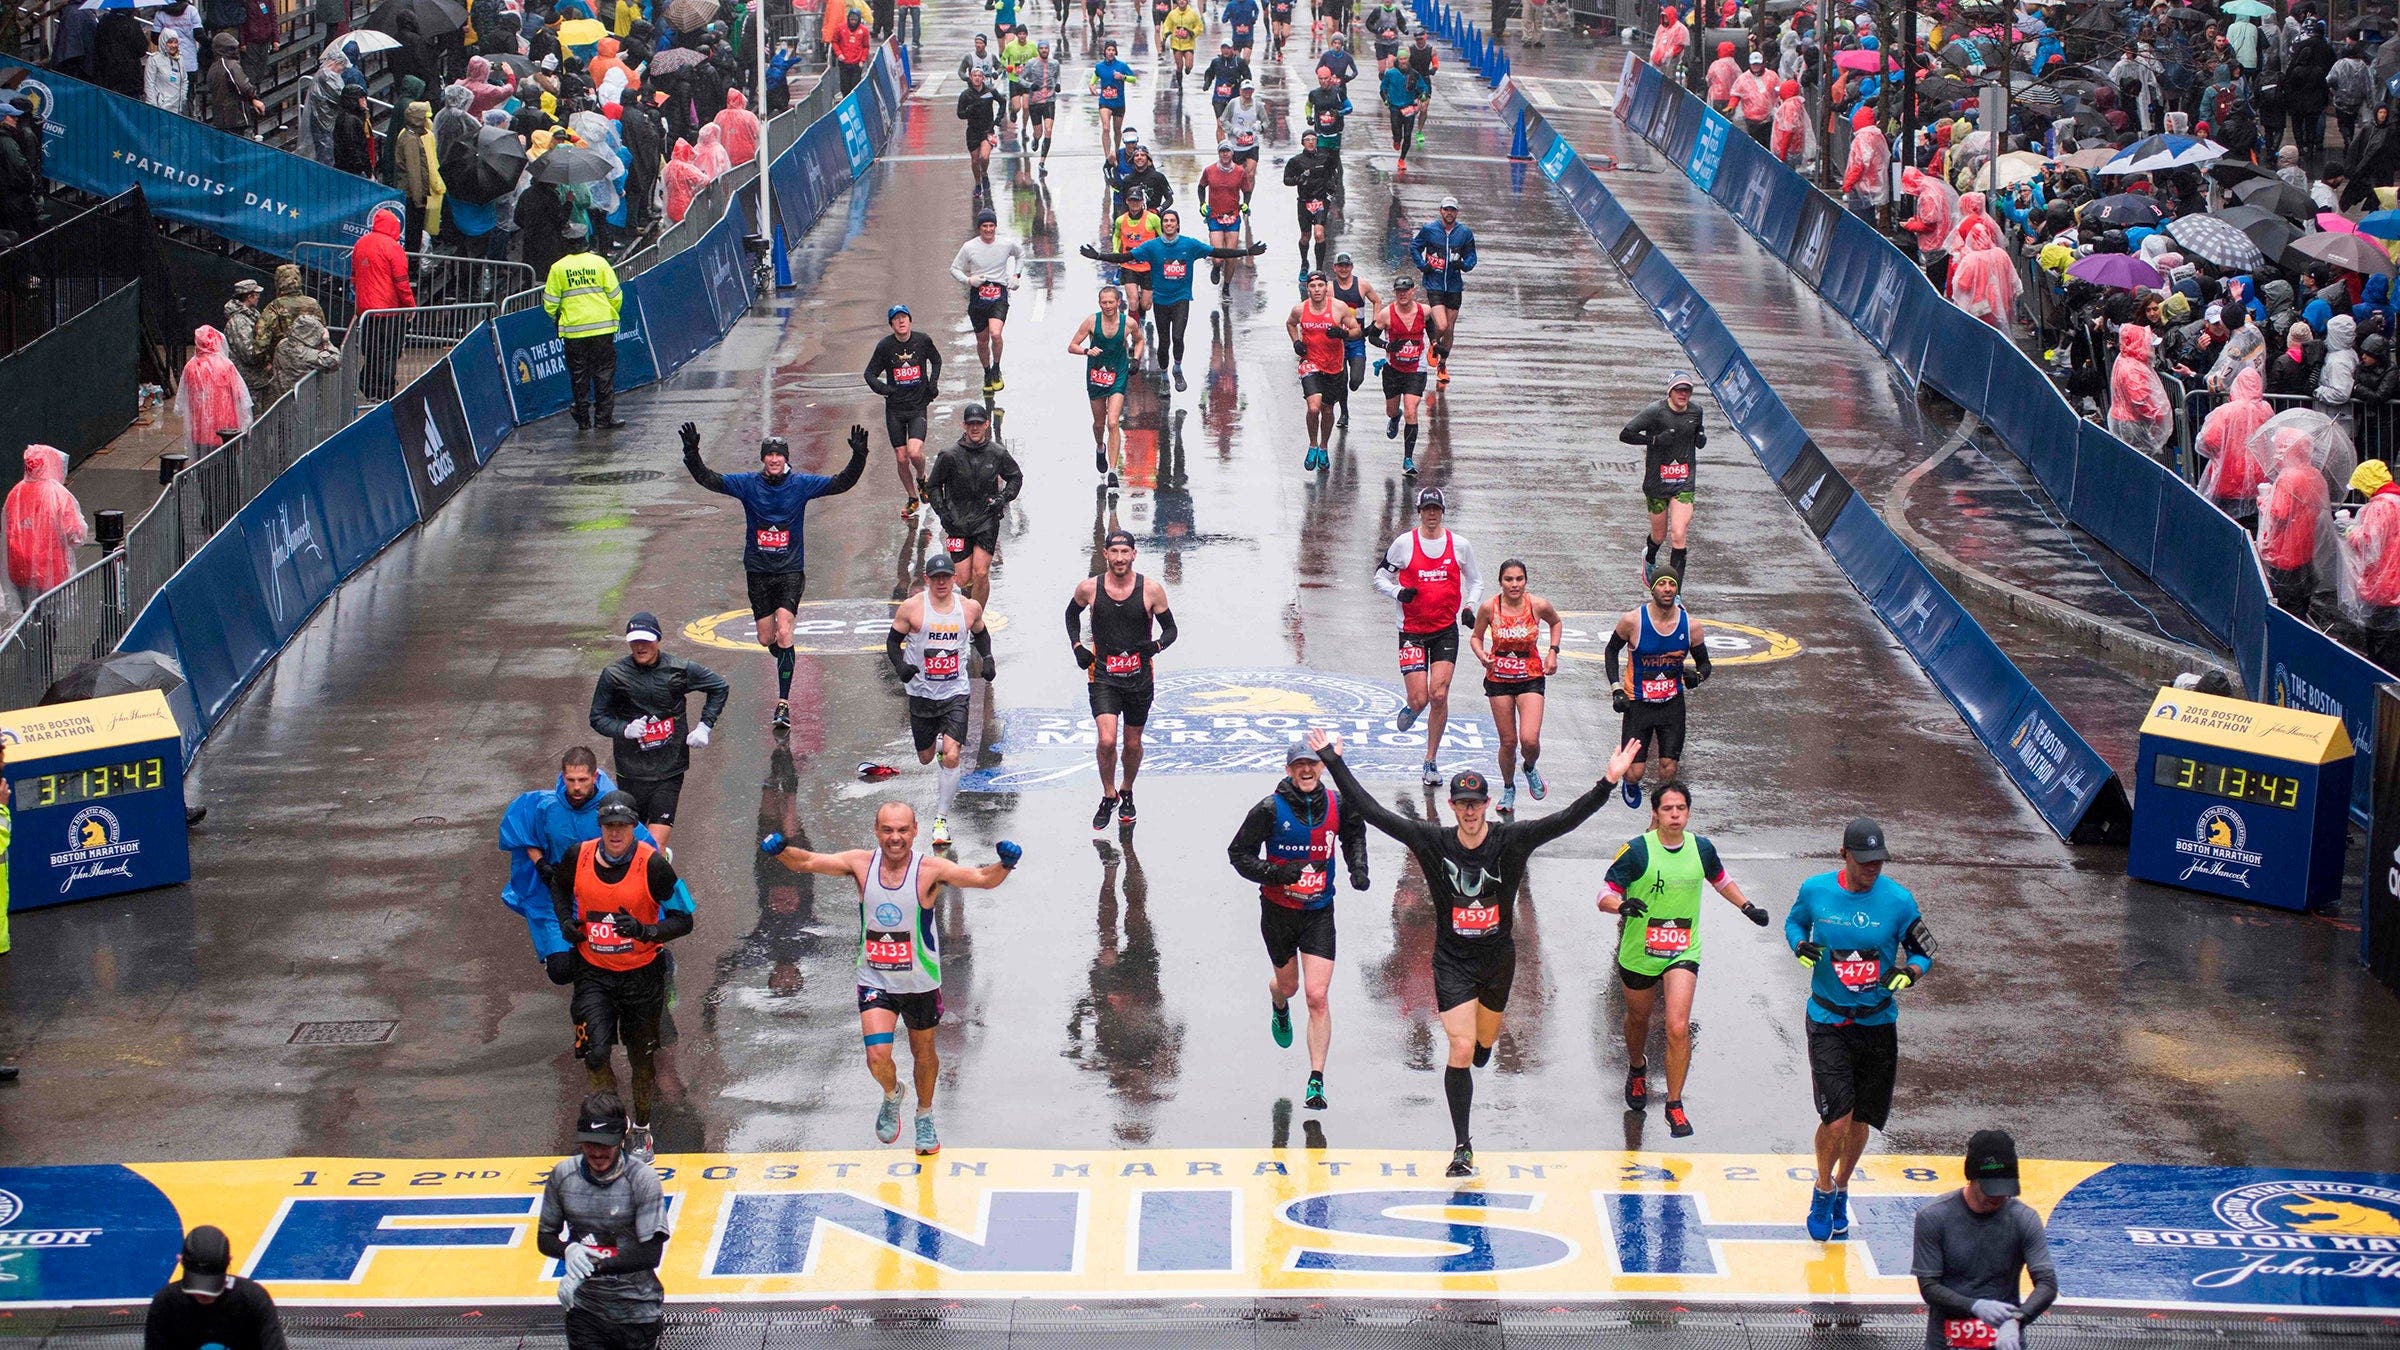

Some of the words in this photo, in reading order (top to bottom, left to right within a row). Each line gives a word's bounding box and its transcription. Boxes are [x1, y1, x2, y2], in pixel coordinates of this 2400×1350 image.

[124, 151, 236, 196] PATRIOTS'
[244, 192, 288, 216] DAY
[2100, 205, 2113, 218] B
[342, 222, 371, 236] BOSTO
[565, 267, 596, 279] Boston
[567, 276, 597, 288] Police
[530, 342, 548, 360] THE
[895, 366, 918, 376] 3809
[1091, 369, 1113, 381] 5196
[426, 450, 455, 487] adidas
[1662, 466, 1686, 475] 3068
[930, 623, 959, 632] TEAM
[928, 632, 958, 641] REAM
[927, 656, 956, 669] 3628
[1110, 655, 1138, 668] 3442
[1497, 658, 1526, 670] 6625
[2291, 672, 2307, 702] THE
[2309, 684, 2342, 717] BOSTON
[1038, 717, 1188, 729] 208
[2184, 705, 2209, 716] 2018
[2211, 710, 2253, 724] BOSTON
[21, 722, 46, 734] 2018
[49, 715, 91, 730] BOSTON
[646, 720, 672, 735] 418
[2180, 714, 2249, 734] MARATHON
[24, 724, 95, 744] MARATHON
[2039, 729, 2068, 765] BOSTON
[2018, 739, 2056, 785] MARATHON
[39, 757, 162, 806] 3:13:43
[2176, 757, 2300, 808] 3:13:43
[74, 807, 98, 824] ATHLETIC
[2204, 806, 2229, 819] ATHLETIC
[50, 851, 87, 865] BOSTON
[88, 841, 140, 859] MARATHON
[2175, 840, 2211, 855] BOSTON
[2212, 848, 2262, 865] MARATHON
[59, 864, 90, 894] John
[88, 858, 133, 878] Hancock
[1298, 873, 1323, 887] 604
[2179, 857, 2209, 881] John
[2208, 861, 2251, 889] Hancock
[1457, 907, 1496, 922] 4597
[1649, 929, 1687, 944] 3506
[870, 942, 907, 957] 2133
[1834, 962, 1875, 978] 5479
[1051, 1160, 1548, 1183] MARATHN
[2223, 1197, 2264, 1229] BOSTON
[2245, 1182, 2352, 1200] ATHLETIC
[2126, 1228, 2317, 1250] BOSTON
[2192, 1252, 2337, 1289] John
